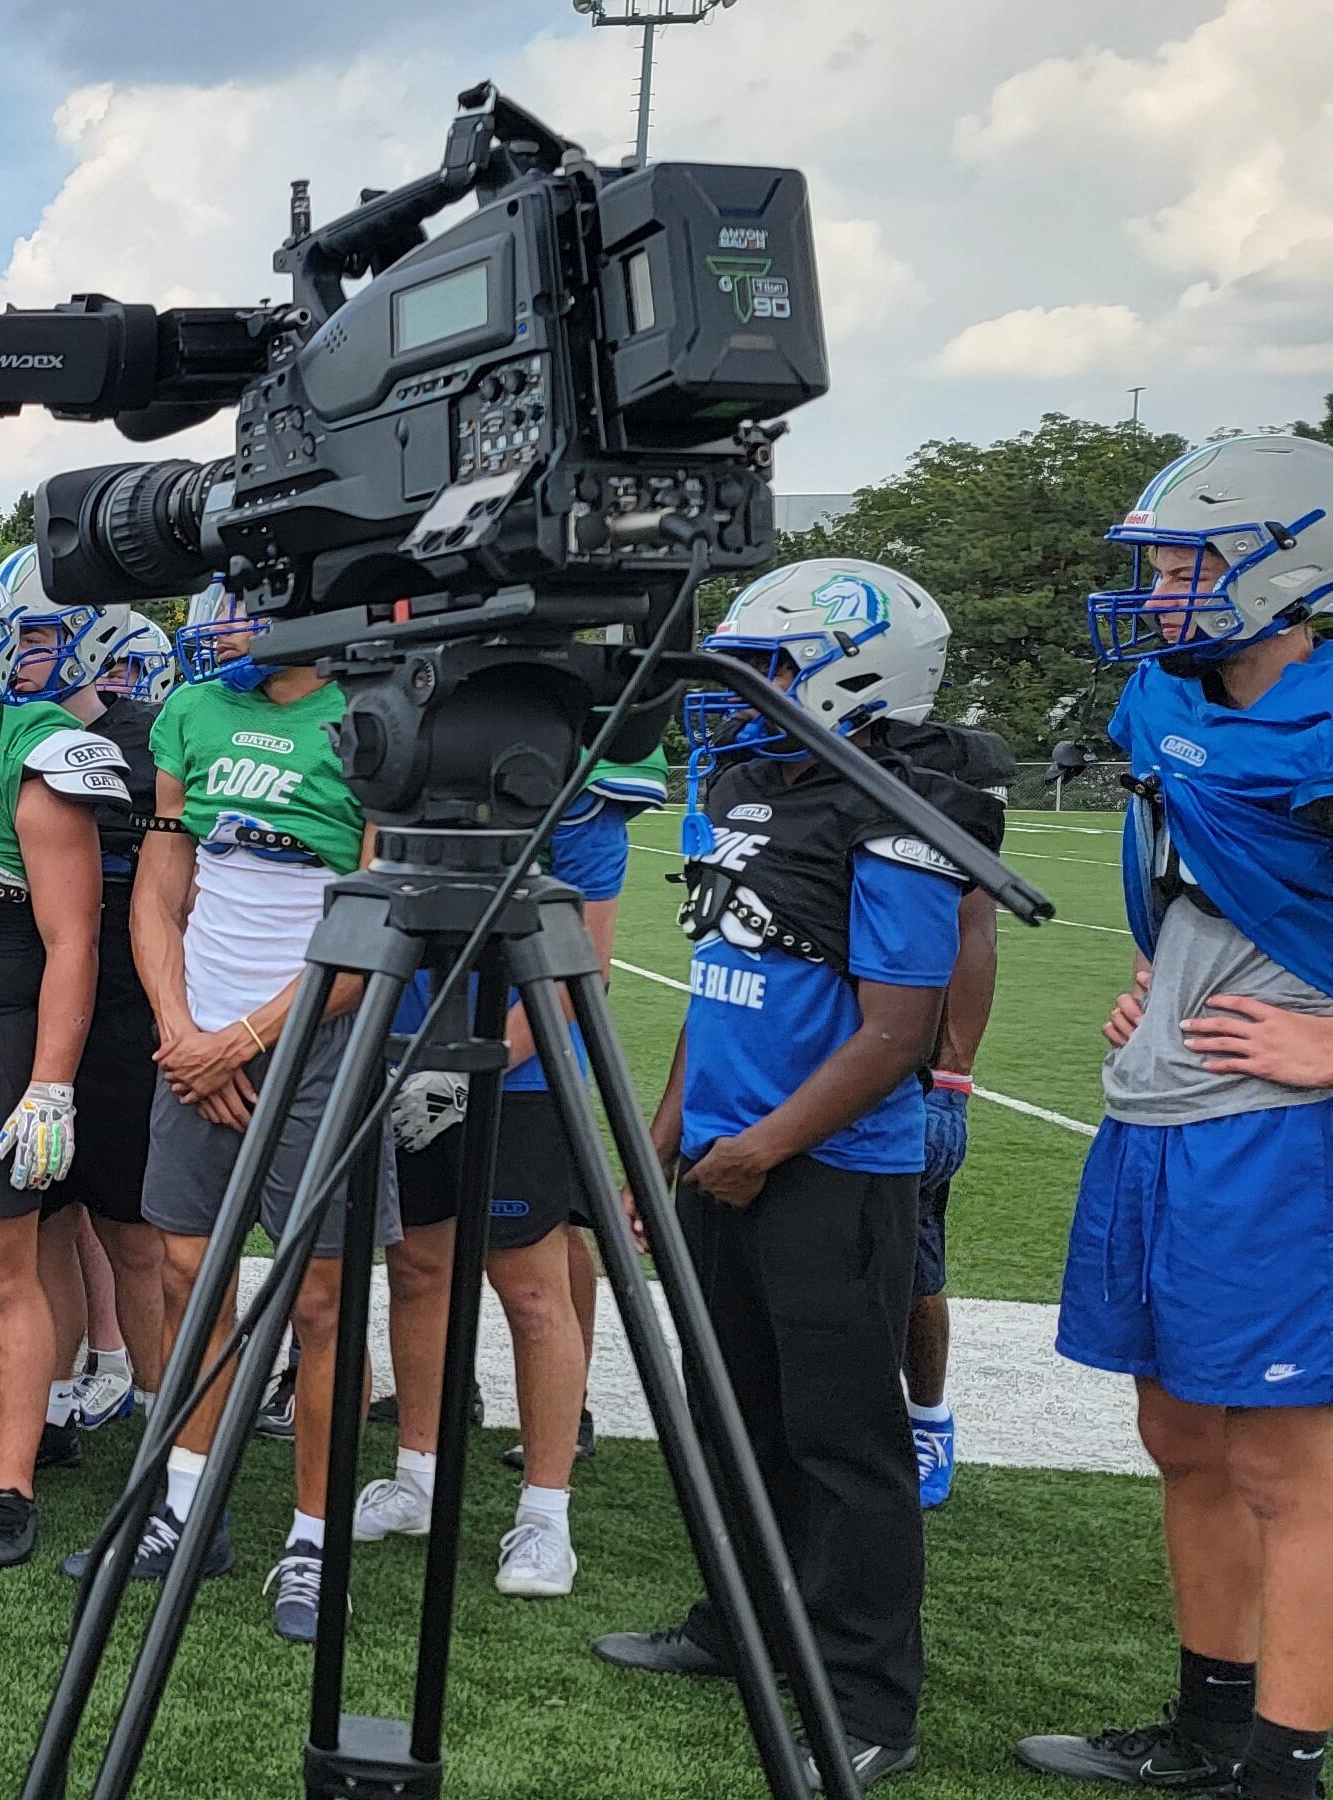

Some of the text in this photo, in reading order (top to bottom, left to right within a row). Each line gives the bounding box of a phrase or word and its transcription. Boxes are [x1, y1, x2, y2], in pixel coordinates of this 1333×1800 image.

[754, 297, 790, 318] 90
[238, 734, 289, 751] BATTLE
[1166, 740, 1203, 762] BATTLE
[206, 758, 303, 804] CODE
[733, 807, 768, 818] BATTLE
[700, 828, 771, 872] DE
[705, 963, 766, 1010] BLUE
